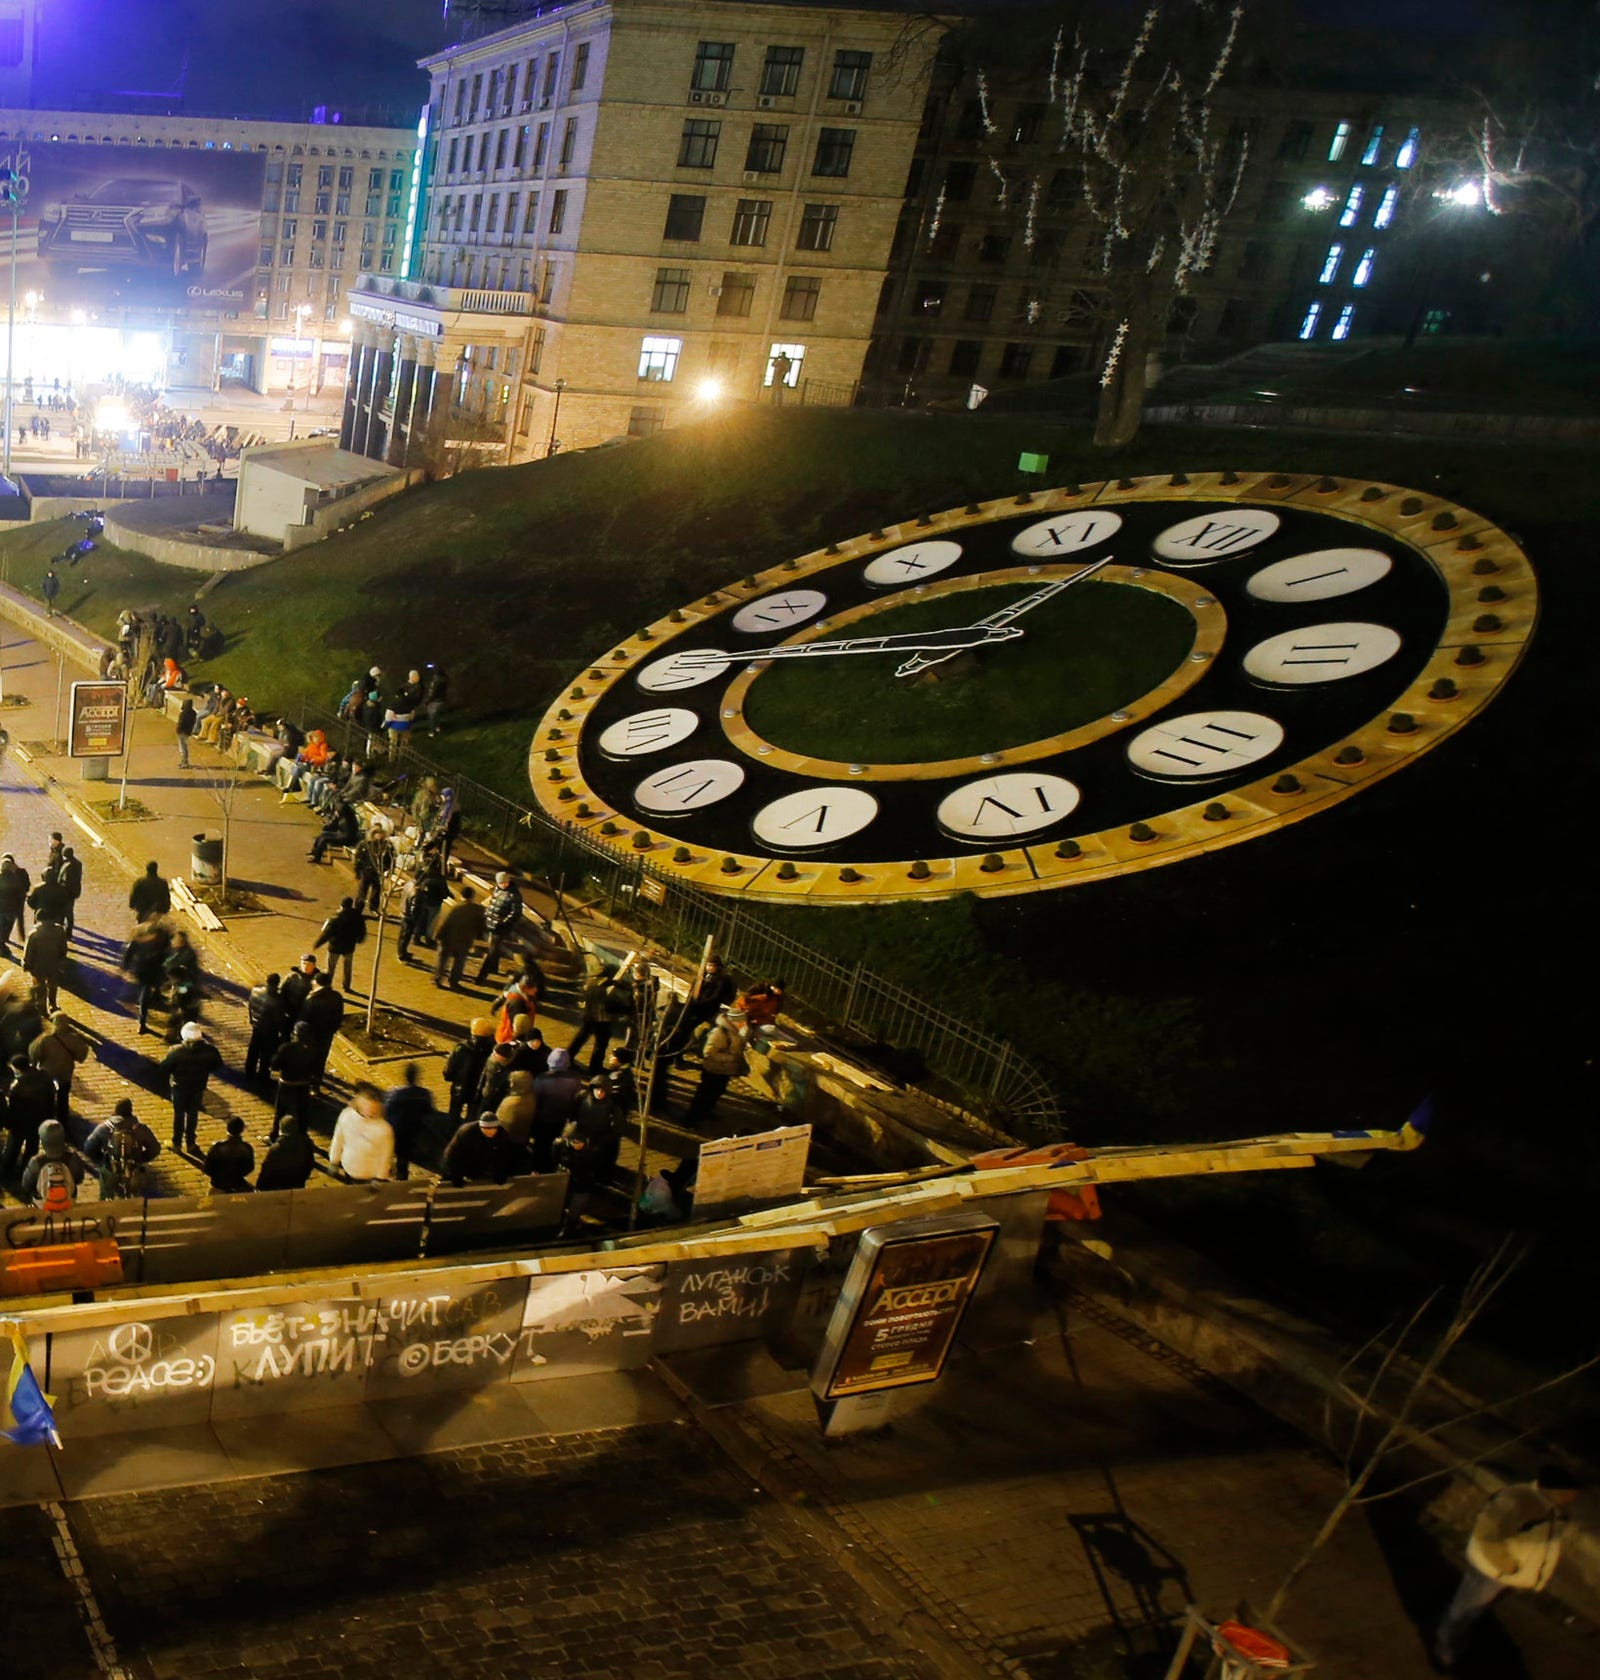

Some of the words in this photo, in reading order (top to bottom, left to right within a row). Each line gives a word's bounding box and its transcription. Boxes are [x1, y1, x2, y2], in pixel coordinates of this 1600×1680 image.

[202, 287, 244, 298] LEXUS
[1037, 521, 1097, 549] XI
[1166, 521, 1263, 552] XII
[896, 553, 927, 575] X
[1284, 567, 1350, 587] I
[754, 599, 809, 623] IX
[1280, 642, 1360, 667] II
[650, 653, 718, 688] VII
[624, 713, 672, 752] VII
[1150, 723, 1261, 768] III
[651, 769, 715, 804] VI
[778, 804, 832, 833] V
[967, 785, 1056, 827] IV
[874, 1327, 890, 1343] 5
[255, 1333, 387, 1380] ЛУПИТ
